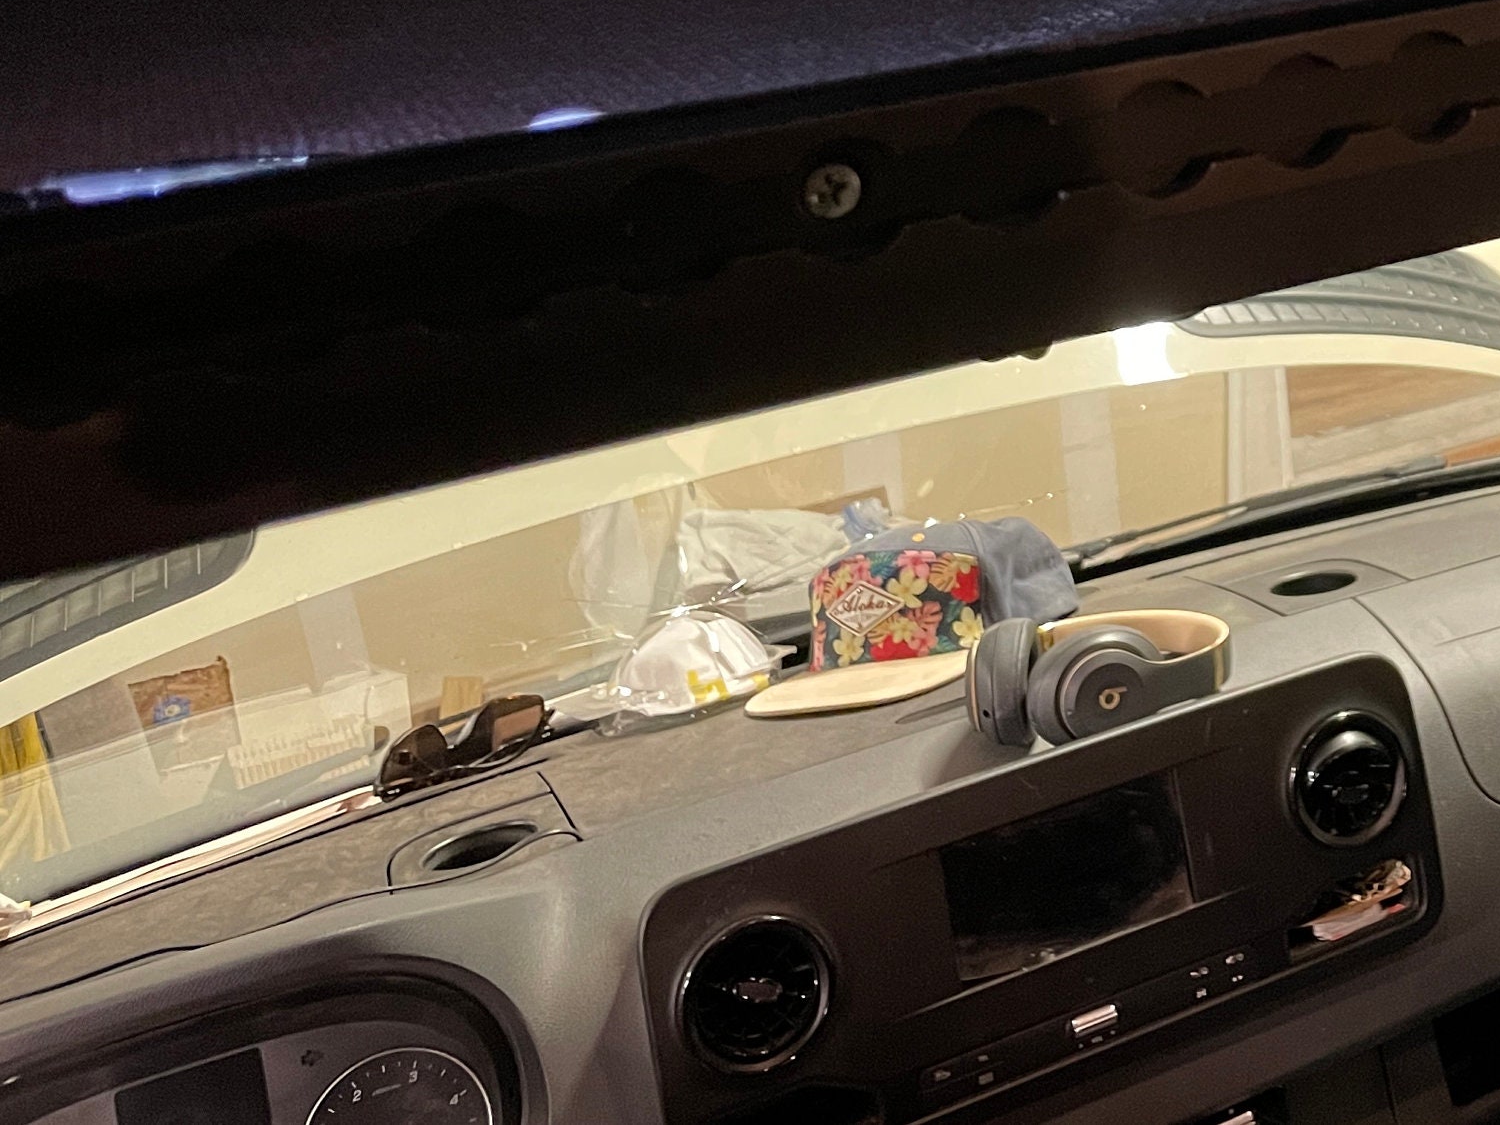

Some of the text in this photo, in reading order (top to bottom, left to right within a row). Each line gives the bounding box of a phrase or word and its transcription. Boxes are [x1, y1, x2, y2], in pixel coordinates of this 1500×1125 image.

[352, 1070, 460, 1106] 2 3 4
